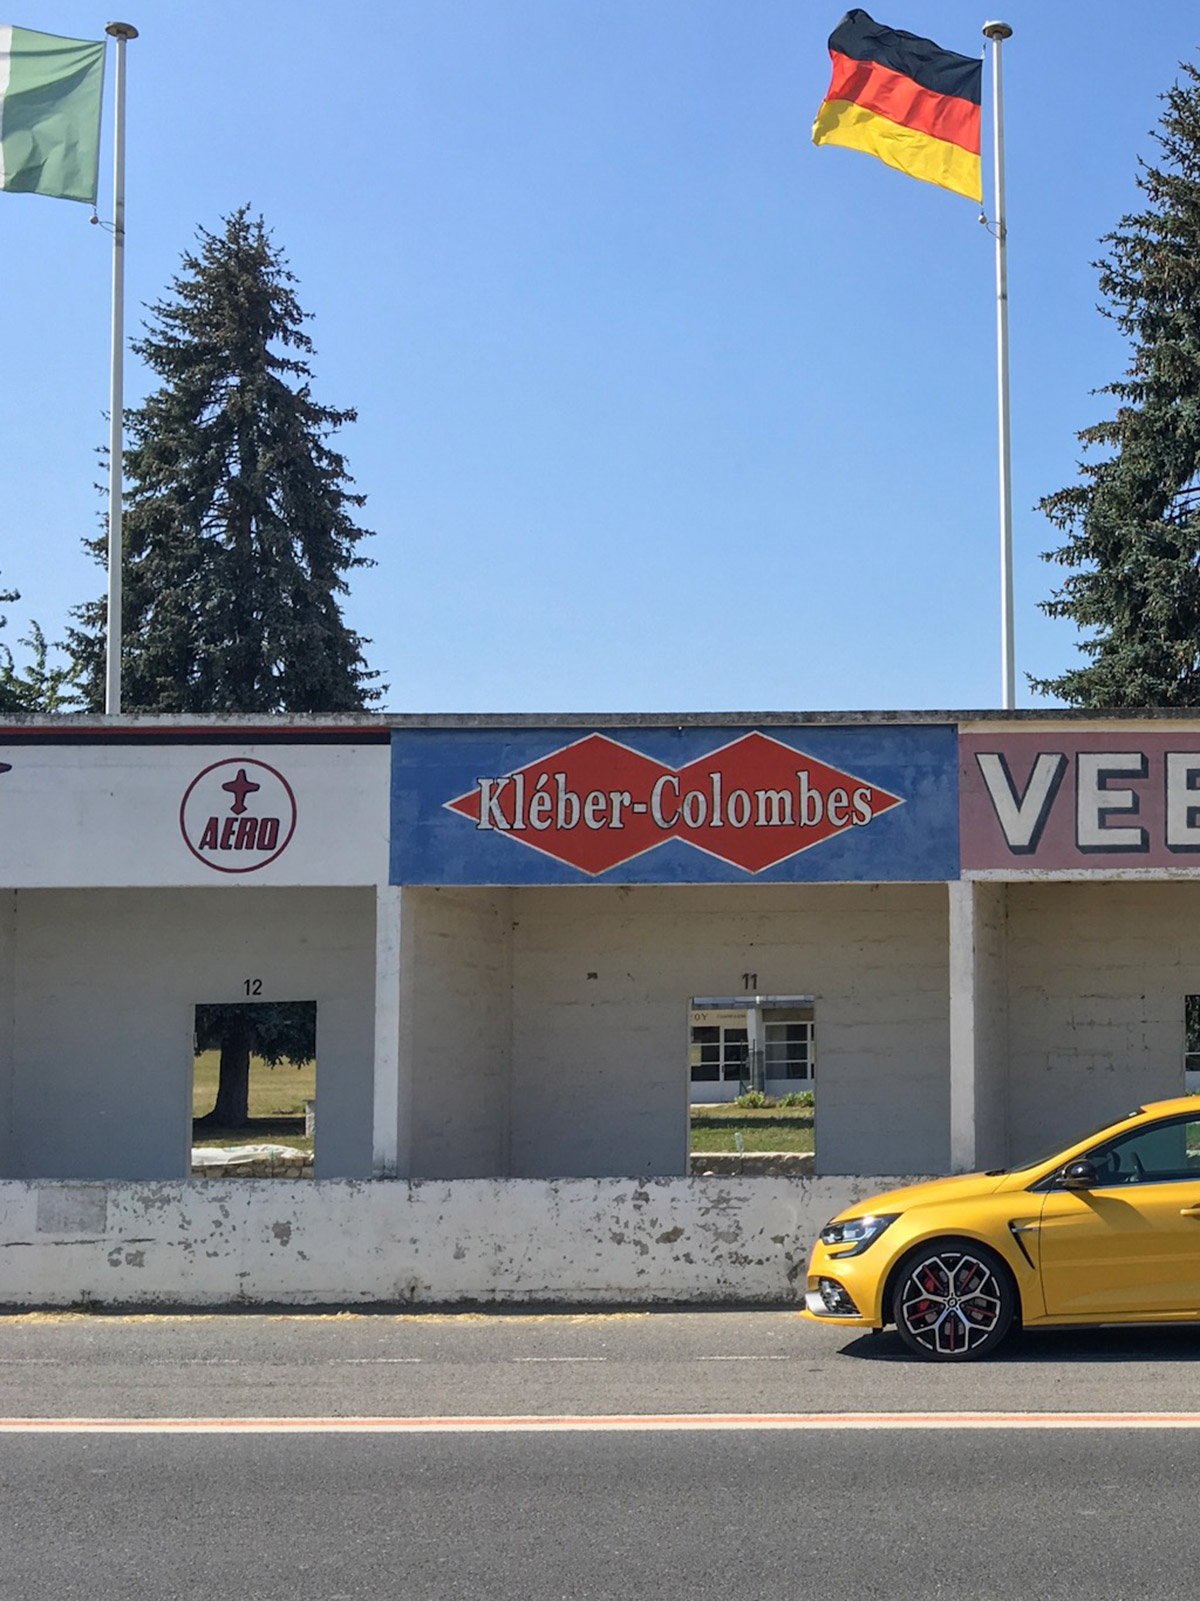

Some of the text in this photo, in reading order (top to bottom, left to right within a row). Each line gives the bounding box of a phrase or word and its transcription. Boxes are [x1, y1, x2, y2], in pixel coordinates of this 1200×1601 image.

[475, 772, 874, 831] Kléber-Colombes
[199, 817, 280, 850] AERO
[243, 979, 263, 996] 12
[741, 972, 758, 990] 11
